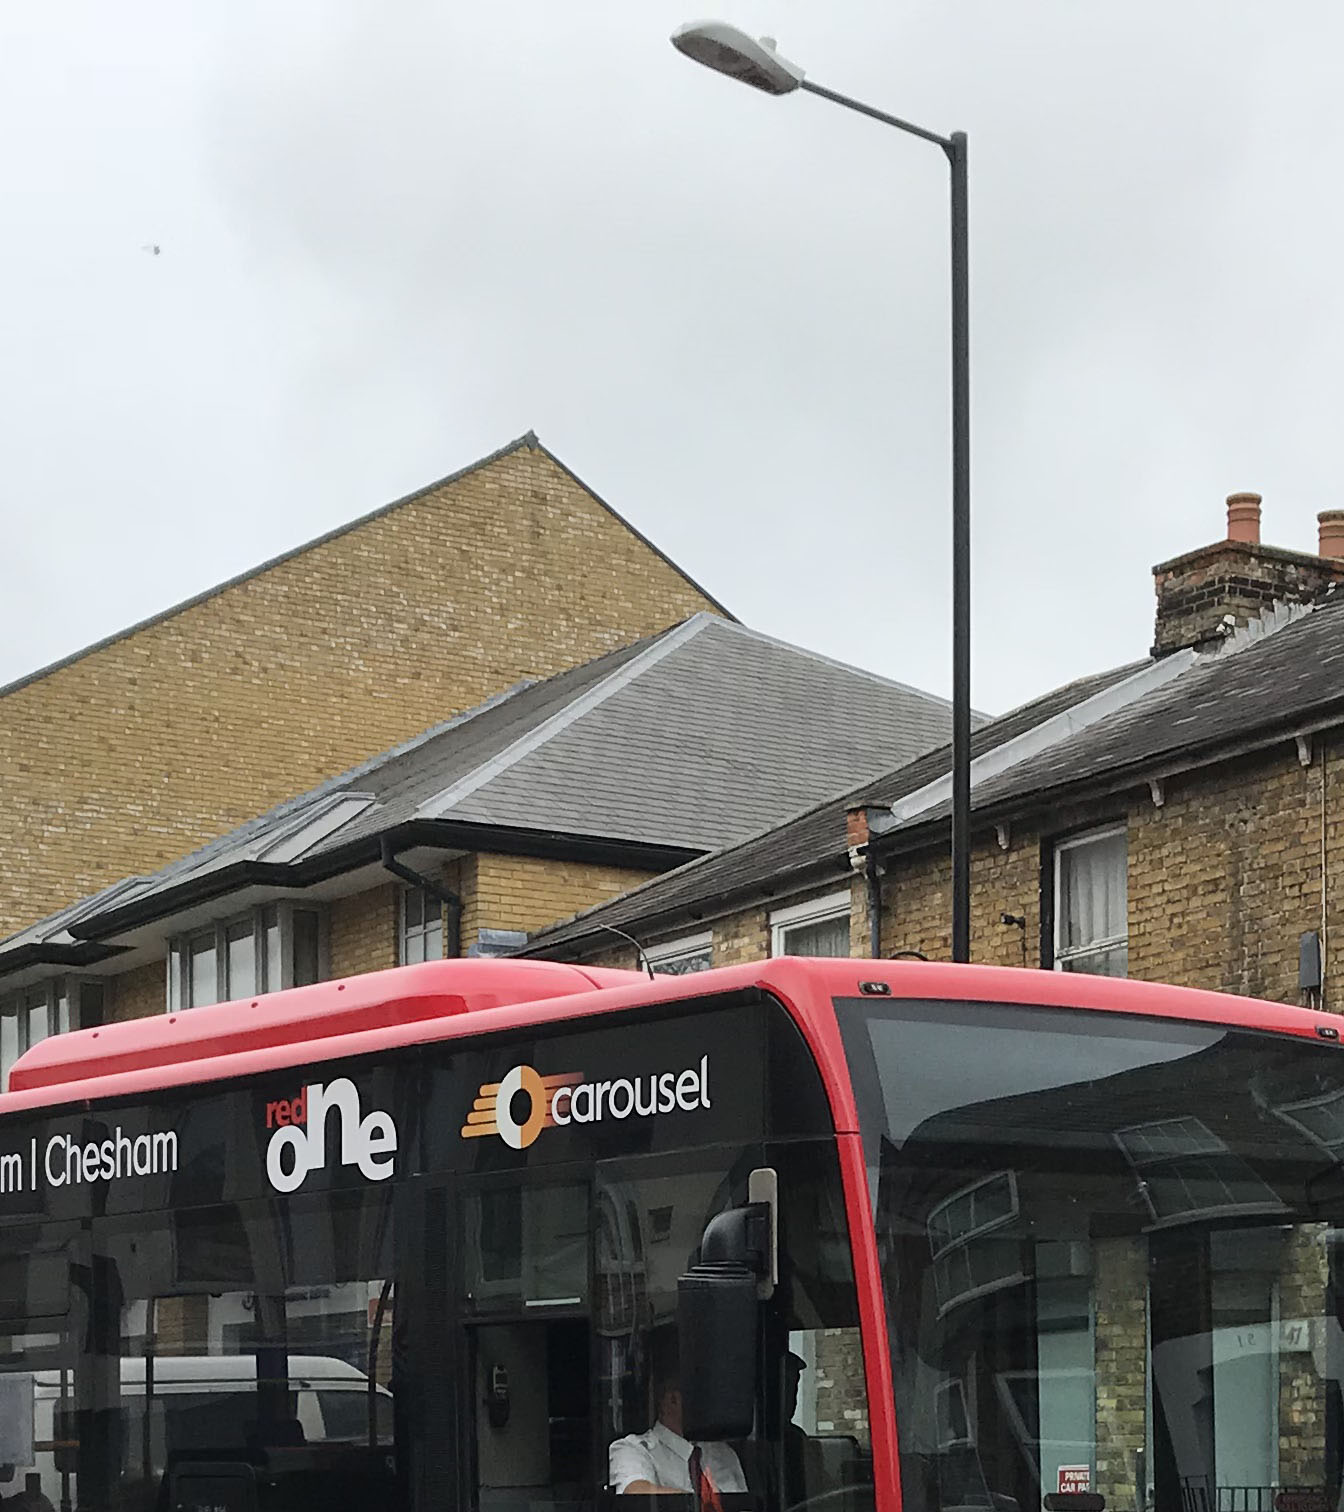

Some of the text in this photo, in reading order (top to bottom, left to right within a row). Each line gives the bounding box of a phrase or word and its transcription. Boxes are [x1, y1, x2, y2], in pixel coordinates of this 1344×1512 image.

[266, 1087, 308, 1128] red
[551, 1055, 711, 1126] carousel
[45, 1126, 178, 1188] Chesham
[266, 1077, 397, 1193] one
